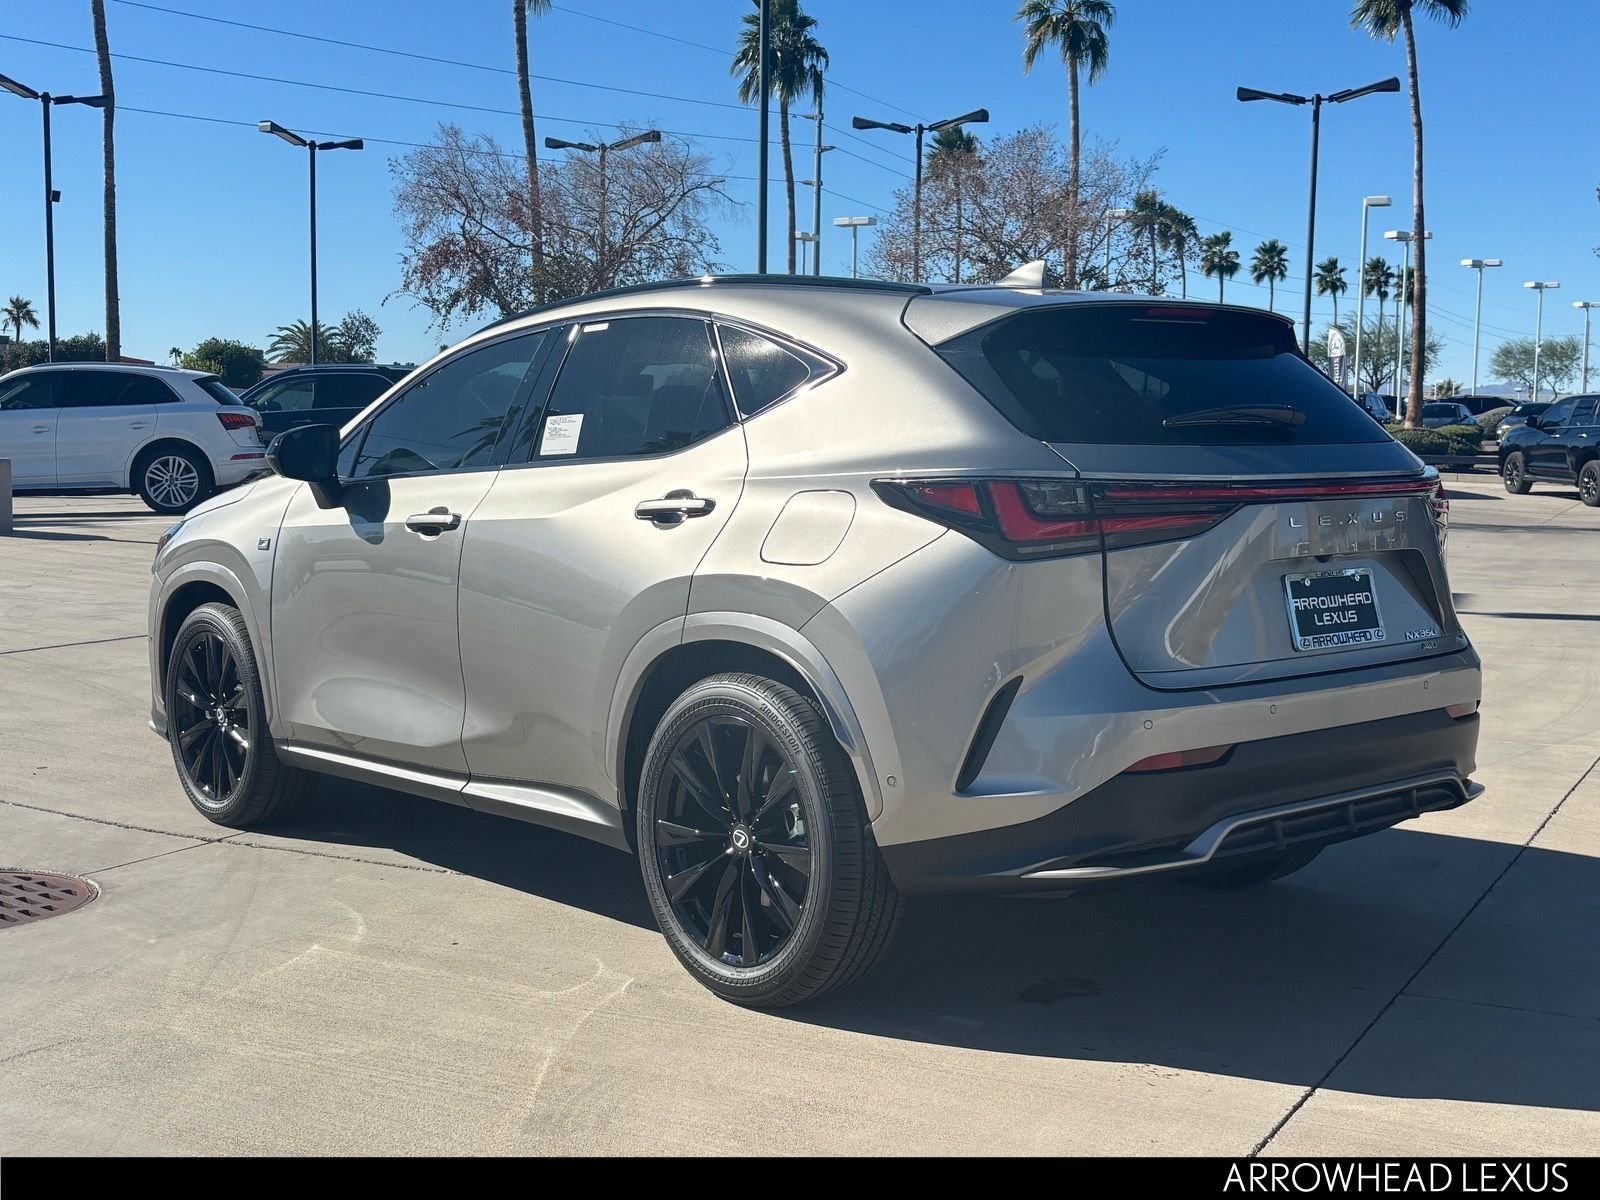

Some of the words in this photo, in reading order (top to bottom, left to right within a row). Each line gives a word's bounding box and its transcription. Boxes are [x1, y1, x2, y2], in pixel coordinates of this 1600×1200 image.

[1289, 511, 1405, 528] LEXUS
[1293, 592, 1372, 611] ARROWHEAD
[1314, 610, 1358, 626] LEXUS
[1312, 631, 1372, 648] ARROWHEAD
[760, 702, 803, 756] BRIDGESTONE
